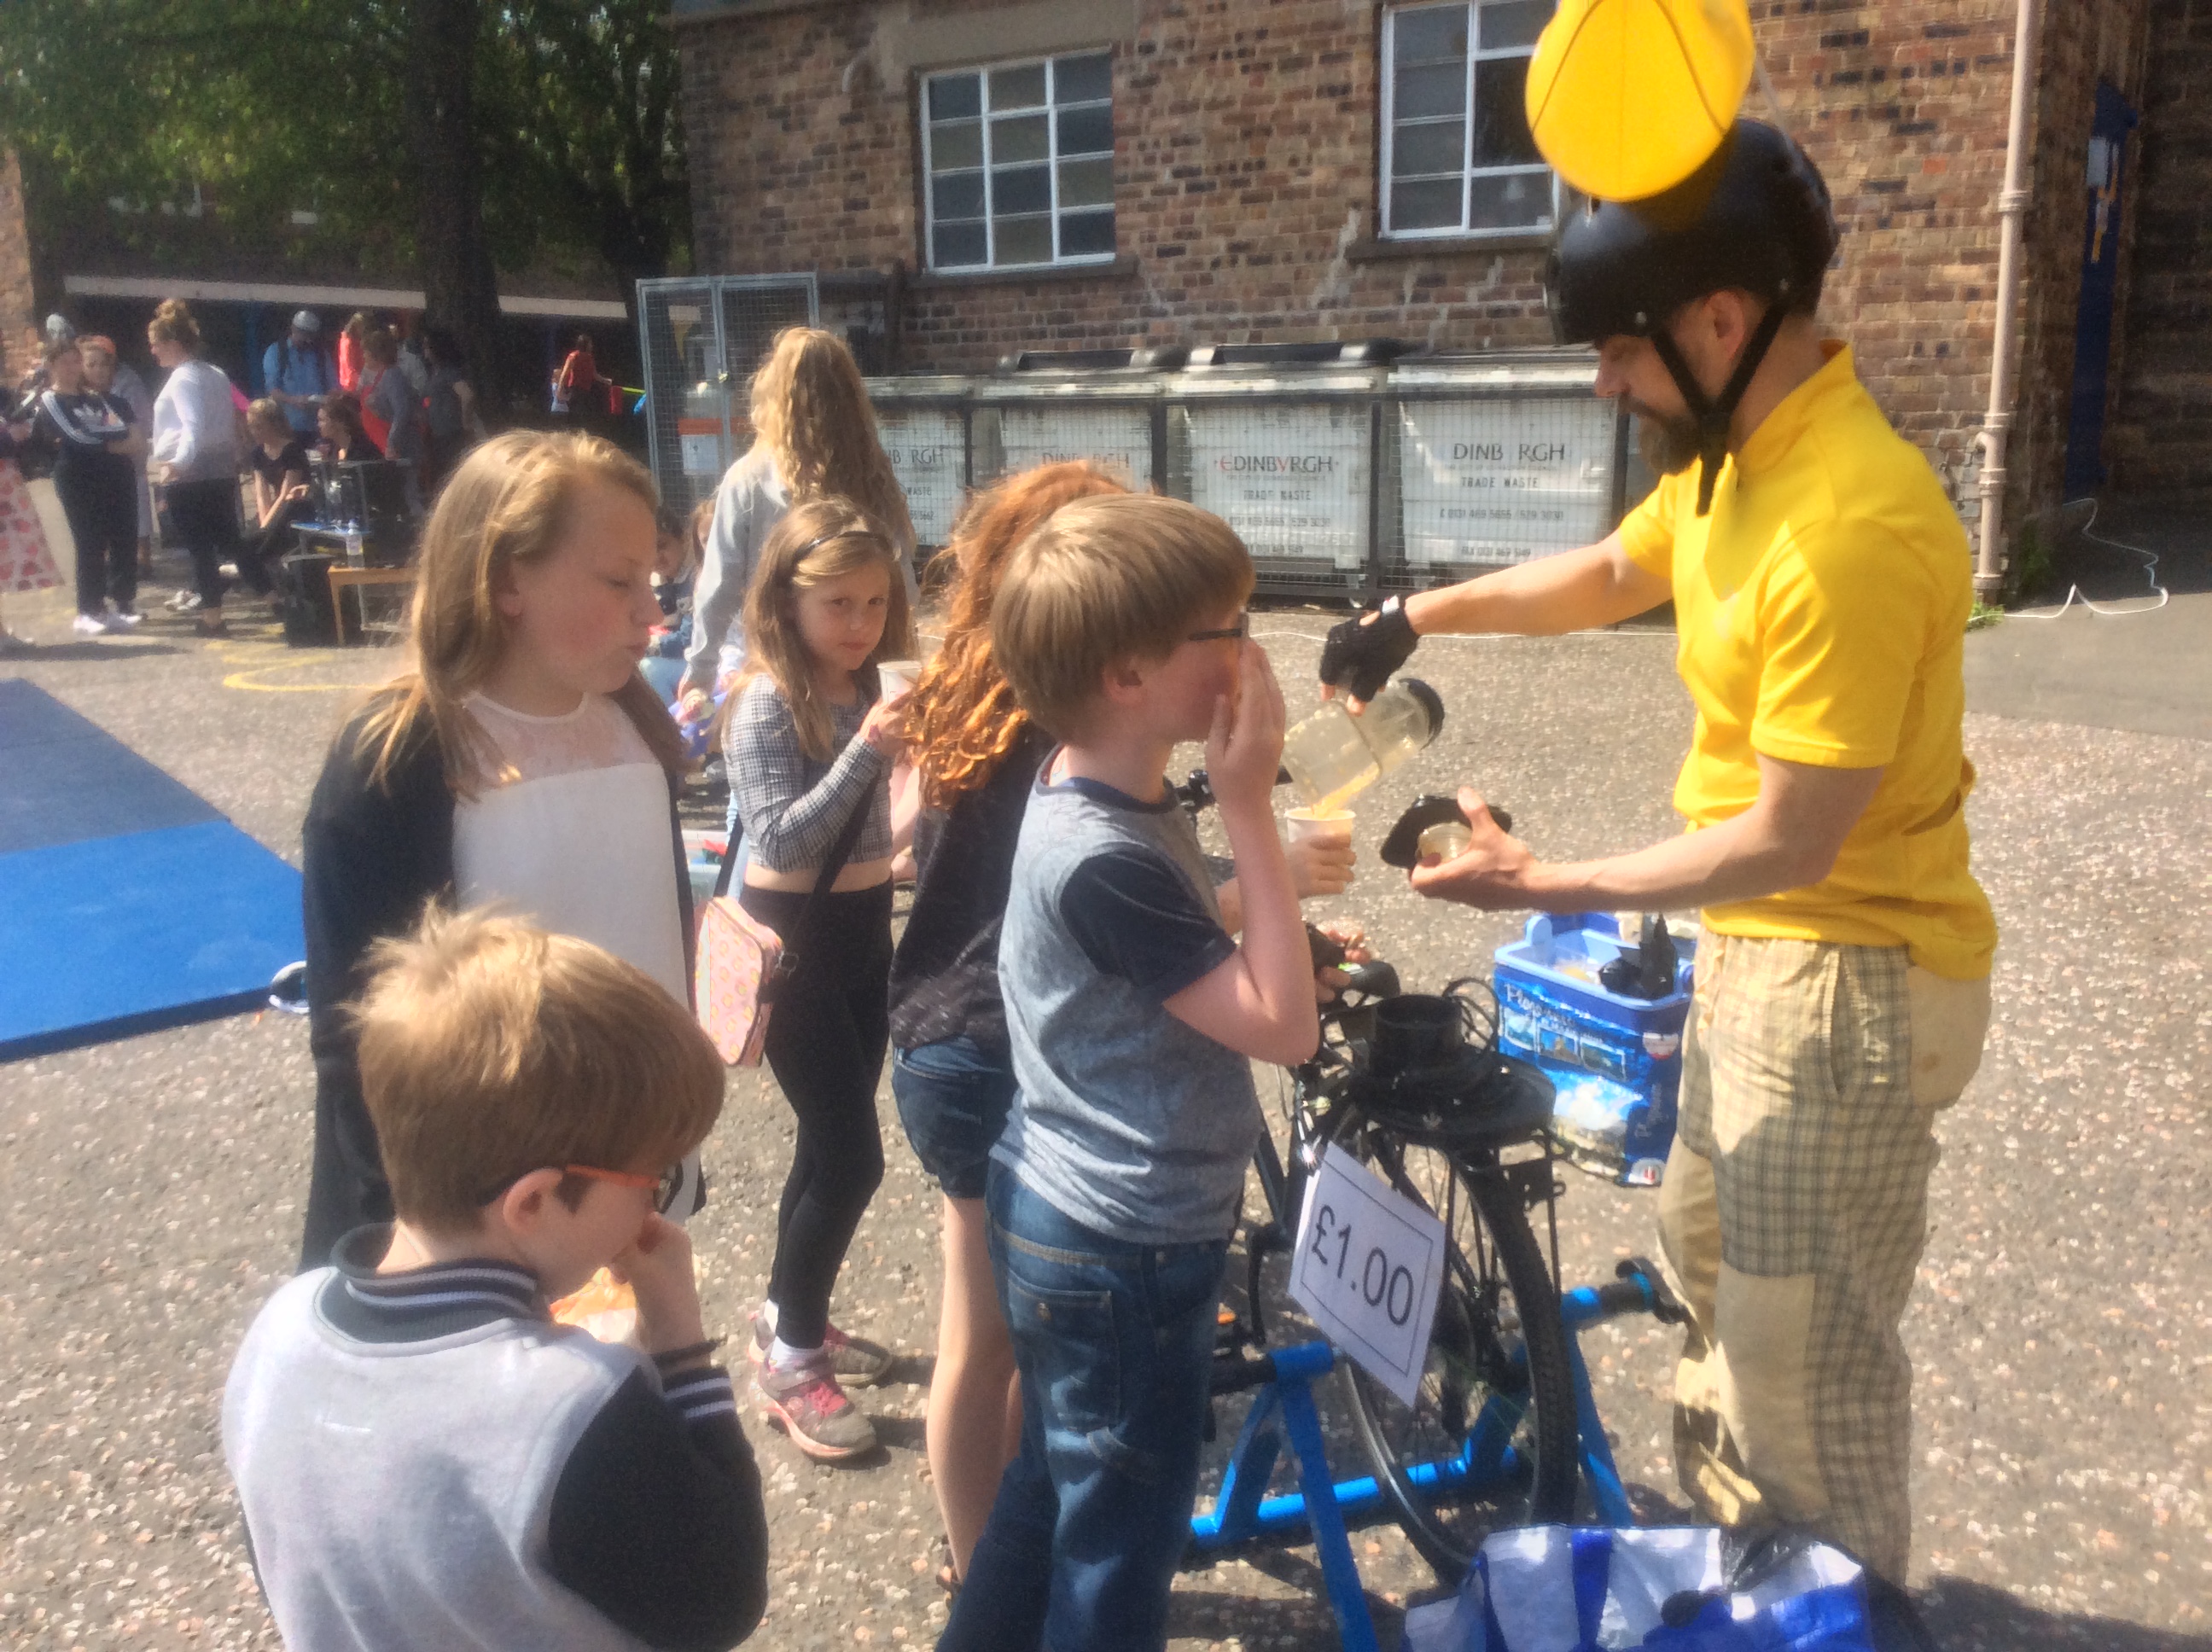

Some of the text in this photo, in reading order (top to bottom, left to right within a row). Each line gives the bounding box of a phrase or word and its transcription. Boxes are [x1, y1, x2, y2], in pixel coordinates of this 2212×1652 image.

[1461, 476, 1540, 489] TRADE WASTE
[1311, 1204, 1415, 1326] £1.00
